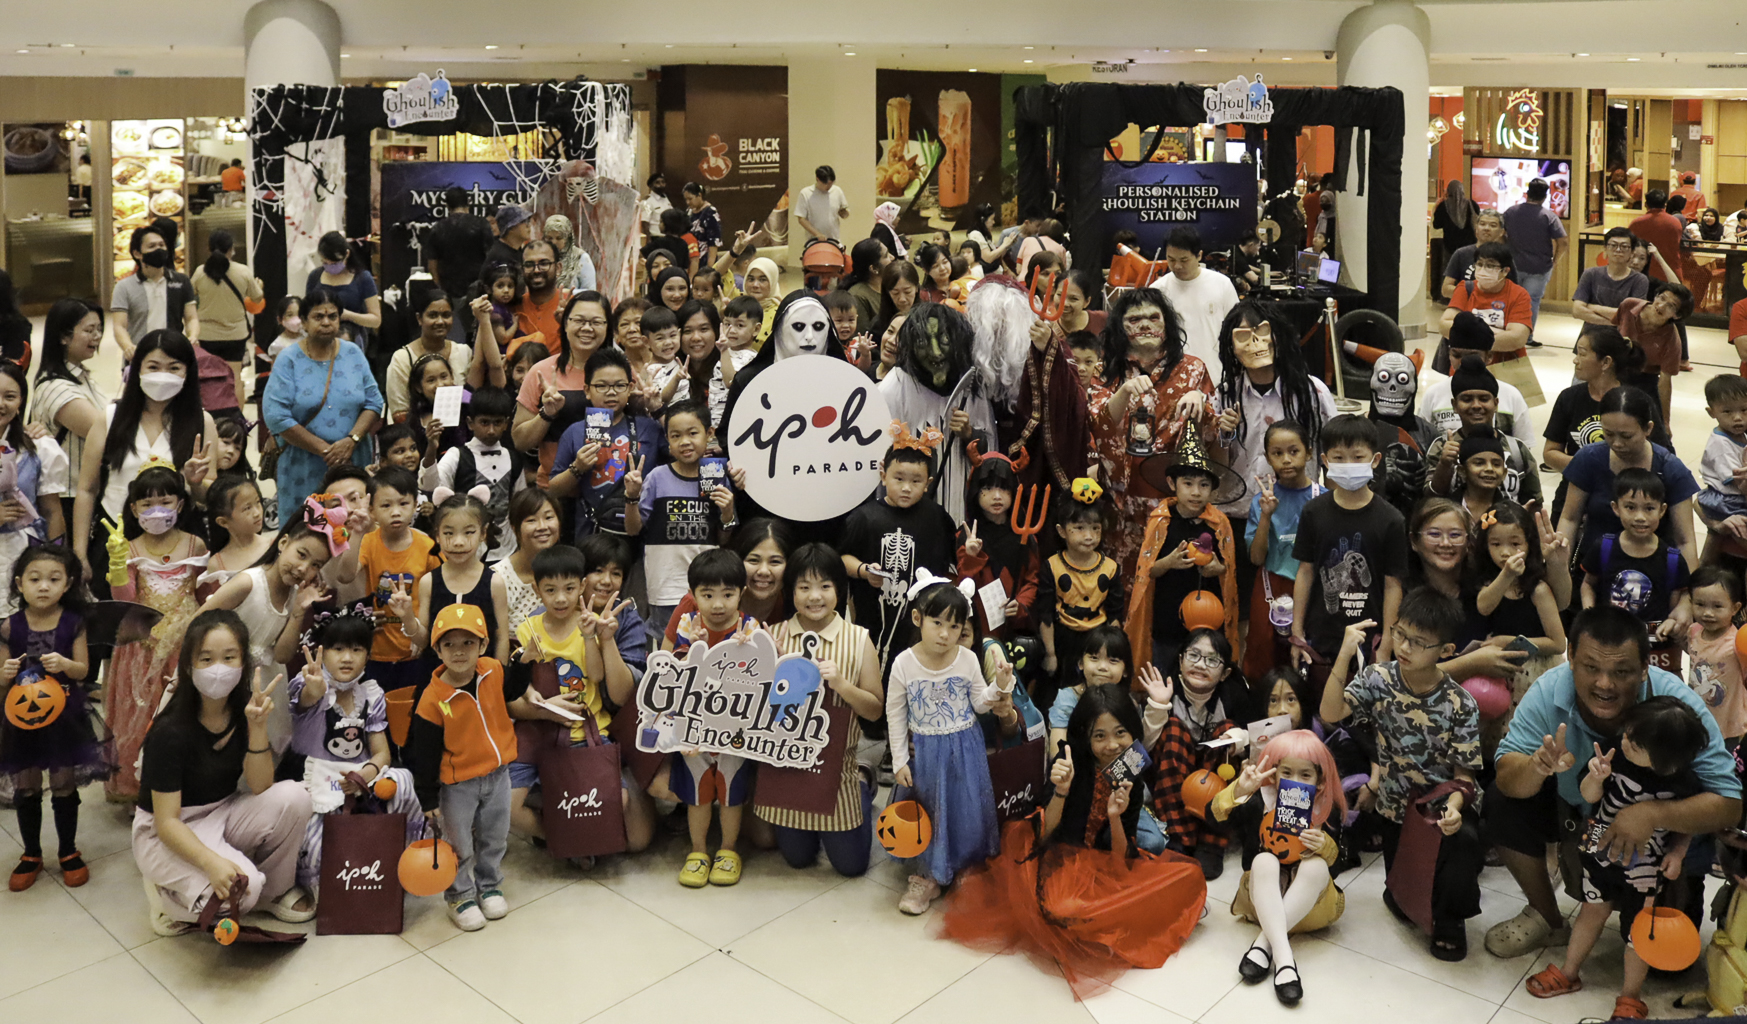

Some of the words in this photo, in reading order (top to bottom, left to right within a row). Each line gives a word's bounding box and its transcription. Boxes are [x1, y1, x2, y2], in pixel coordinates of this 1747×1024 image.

[386, 90, 456, 113] Ghoulish
[1206, 92, 1271, 113] Ghoulish
[1223, 111, 1270, 122] Encounter
[739, 138, 780, 151] BLACK
[739, 152, 780, 163] CANYON
[410, 184, 497, 208] MYSRY
[1119, 186, 1219, 197] PERSONALISED
[1172, 198, 1240, 211] KEYCHAIN
[1140, 210, 1197, 222] STATION
[734, 386, 883, 479] ipoh
[793, 460, 878, 475] PARADE
[666, 500, 710, 513] FOCUS
[666, 523, 710, 540] GOOD
[1339, 592, 1368, 600] GAMERS
[1345, 609, 1362, 618] QUIT
[712, 652, 759, 680] ipoh
[643, 664, 825, 742] Ghoulish
[682, 716, 814, 763] Encounter
[556, 788, 603, 819] ipoh
[998, 783, 1034, 816] ipoh
[1278, 815, 1298, 825] TREAT
[336, 860, 385, 891] ipoh
